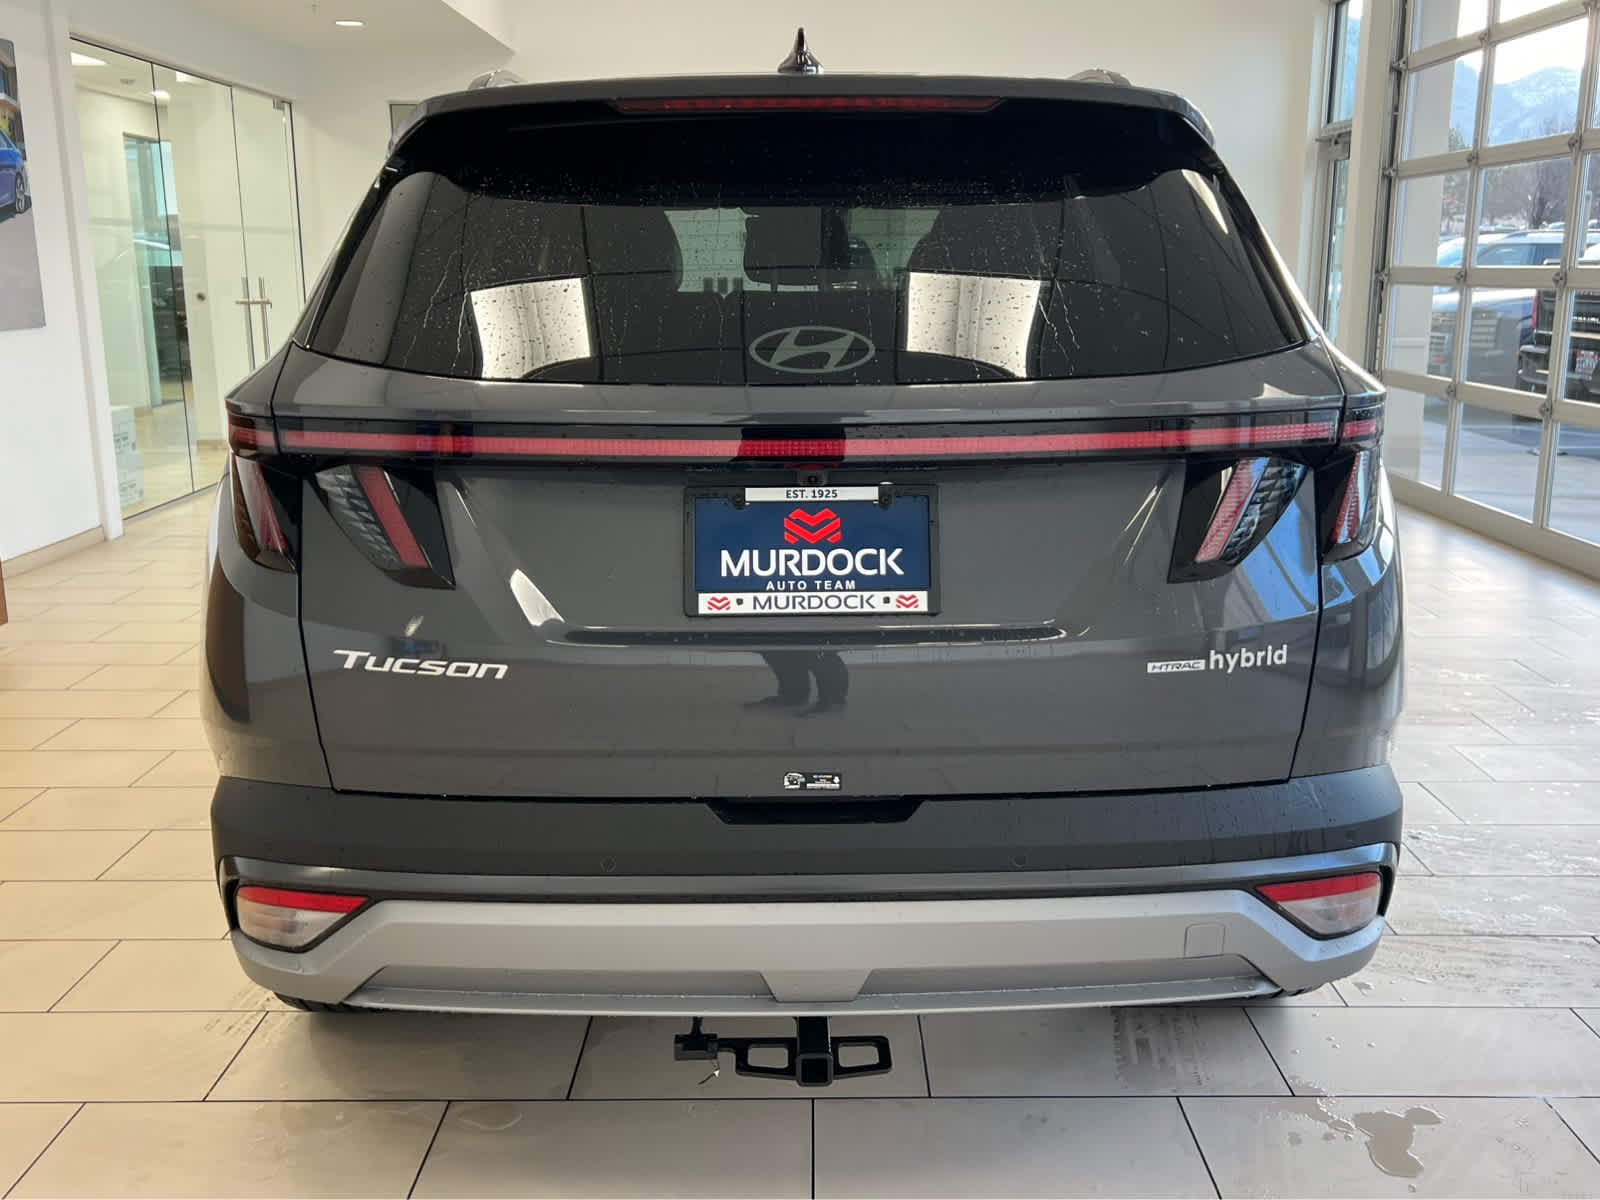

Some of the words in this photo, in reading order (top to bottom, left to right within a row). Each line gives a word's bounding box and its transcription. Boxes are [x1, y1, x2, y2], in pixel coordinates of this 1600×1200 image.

[786, 489, 808, 499] EST.
[811, 489, 838, 498] 1925
[720, 548, 904, 577] MURDOCK
[766, 580, 807, 591] AUTO
[815, 580, 856, 590] TEAM
[752, 594, 876, 610] MURDOCK
[333, 649, 508, 680] Tucson
[1150, 660, 1202, 671] HTRAC
[1209, 644, 1288, 673] hybrid
